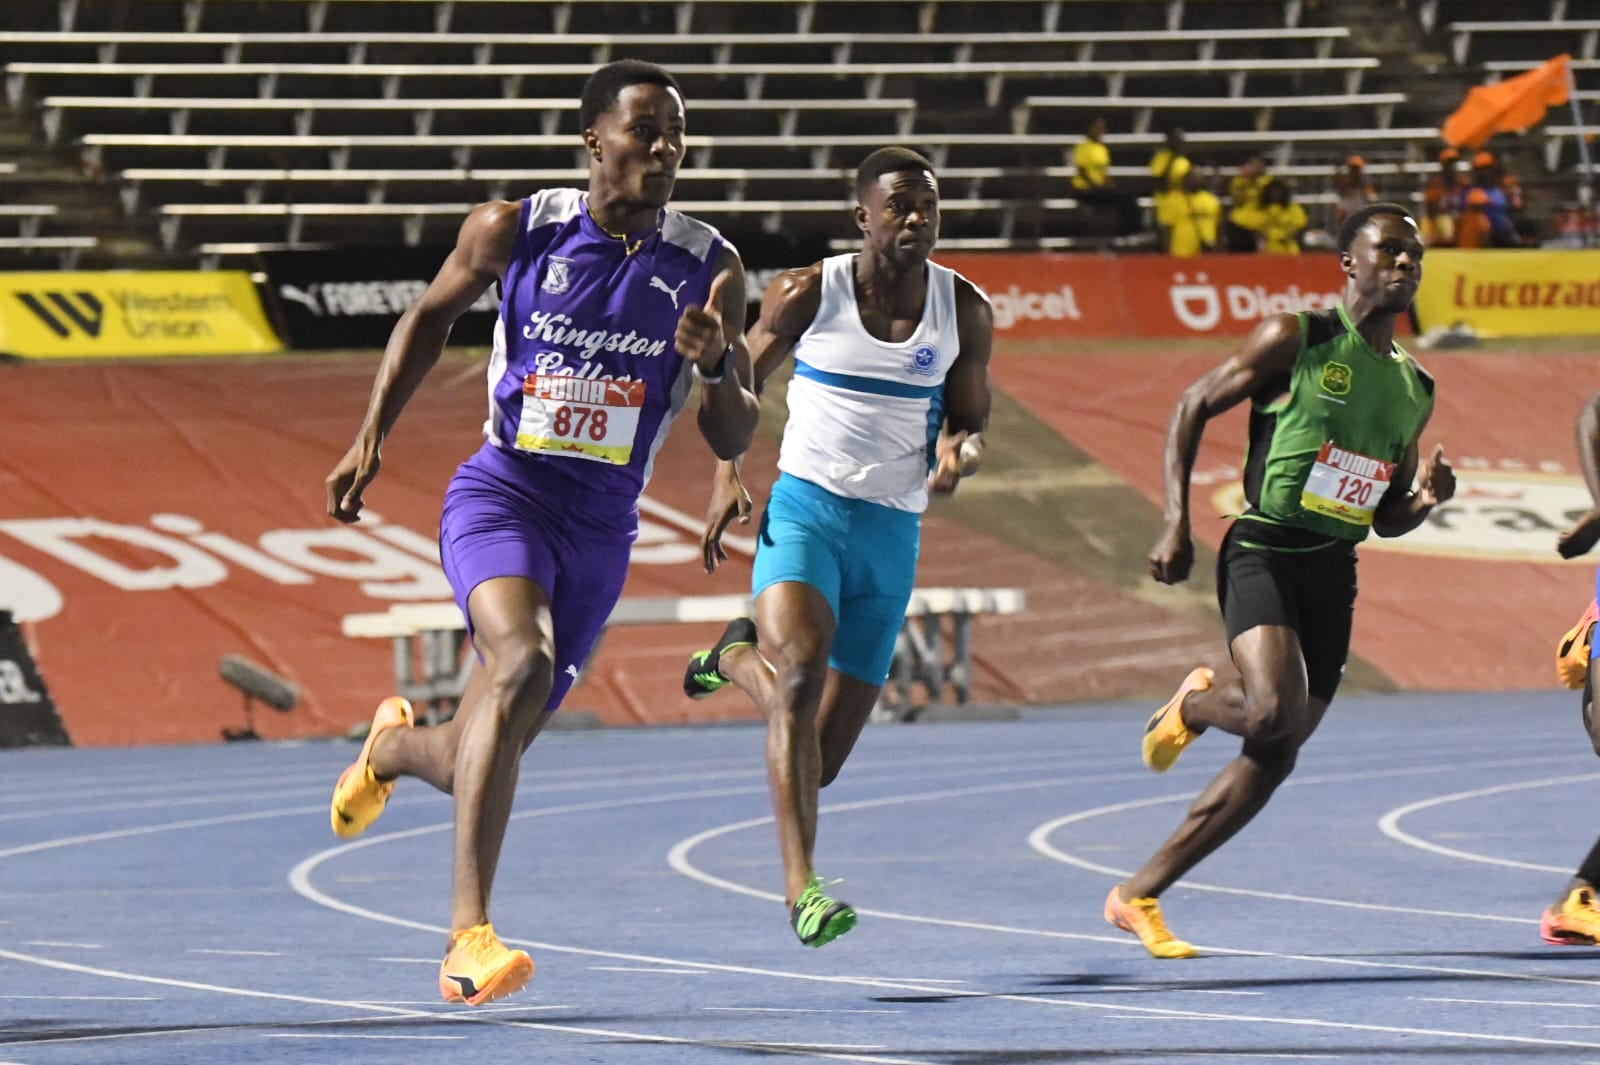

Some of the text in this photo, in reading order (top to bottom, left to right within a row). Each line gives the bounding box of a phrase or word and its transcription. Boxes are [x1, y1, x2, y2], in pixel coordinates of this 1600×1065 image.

[991, 284, 1081, 328] gicel
[1226, 283, 1346, 320] Digice
[523, 310, 667, 360] Kingston
[535, 351, 643, 382] Coll
[535, 377, 606, 405] PUMA
[553, 405, 608, 442] 878
[1327, 447, 1378, 479] PUMA
[1335, 475, 1373, 506] 120
[0, 492, 758, 600] Digiel
